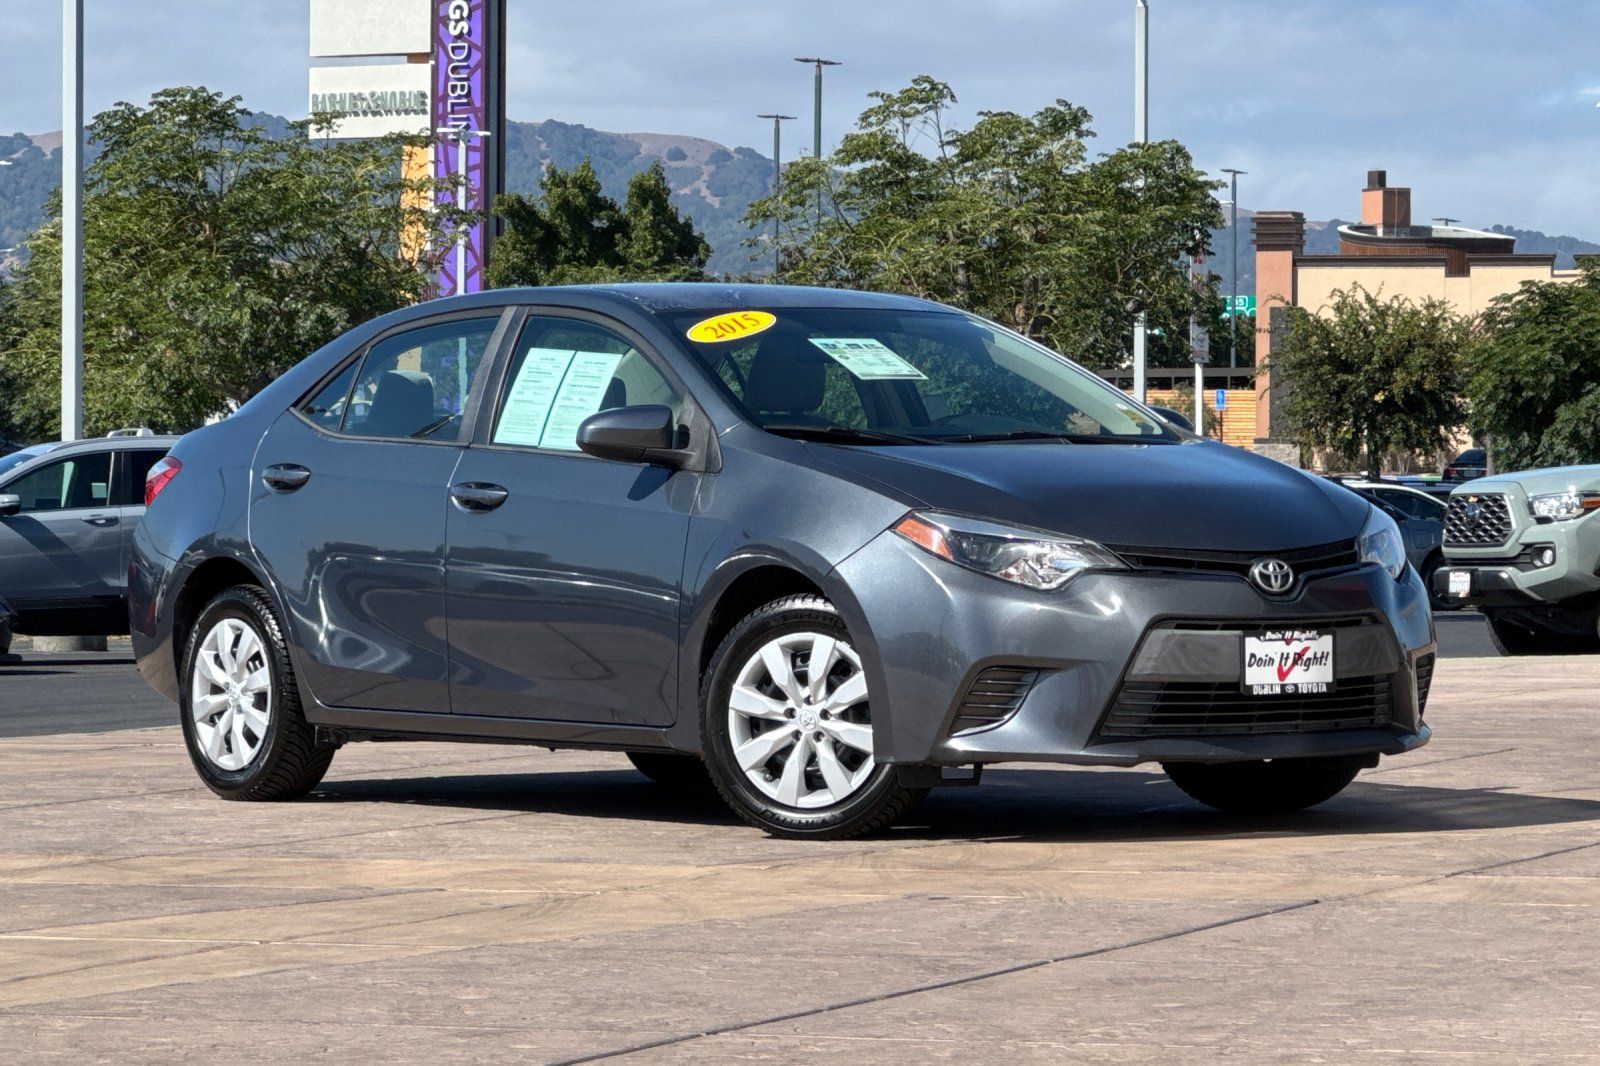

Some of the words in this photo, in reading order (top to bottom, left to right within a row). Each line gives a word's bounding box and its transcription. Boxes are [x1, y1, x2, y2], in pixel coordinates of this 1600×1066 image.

[448, 0, 469, 36] GS
[447, 43, 469, 140] DUBLIN
[704, 313, 760, 339] 2015
[1279, 652, 1290, 667] It
[1293, 651, 1329, 672] Right!
[1252, 684, 1281, 695] DUBLIN
[1297, 682, 1327, 693] TOYOTA
